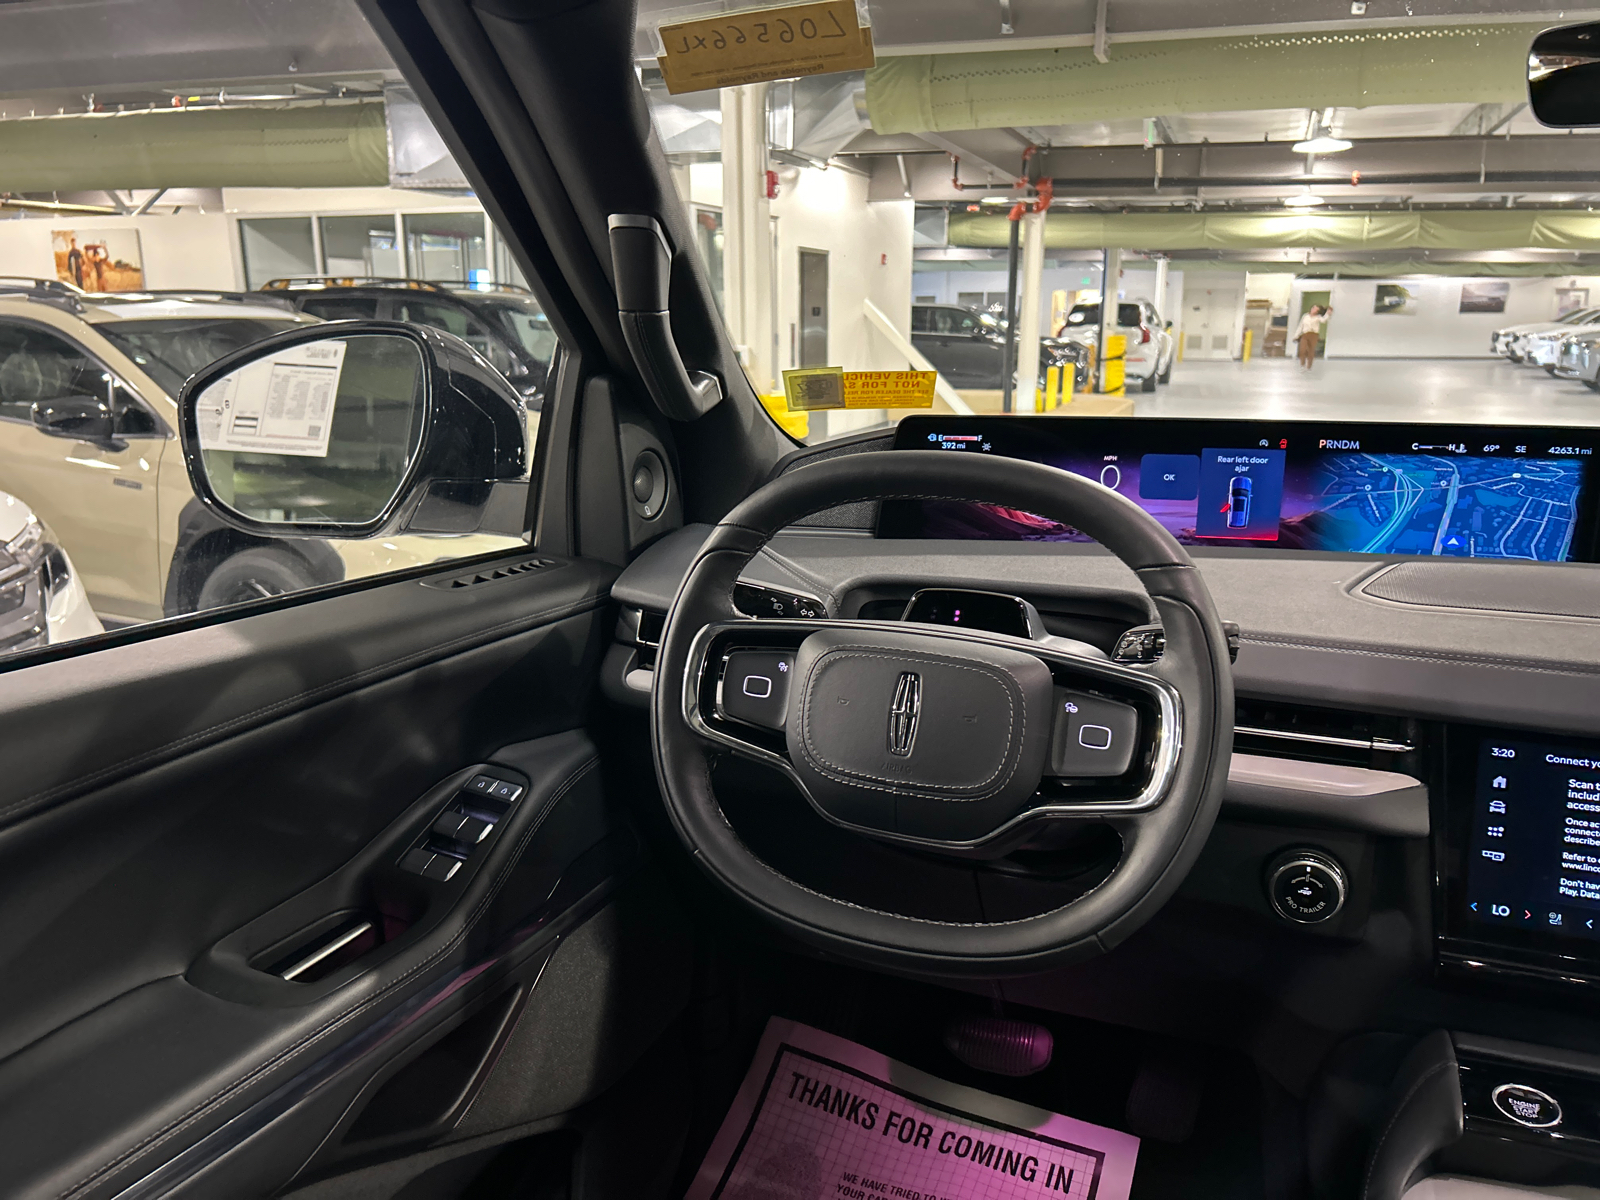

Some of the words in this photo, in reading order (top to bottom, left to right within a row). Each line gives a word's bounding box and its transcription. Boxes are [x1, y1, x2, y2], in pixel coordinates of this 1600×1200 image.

[938, 434, 943, 442] E
[977, 434, 983, 442] F
[1319, 439, 1360, 450] PRNDM
[1412, 443, 1419, 451] C
[1448, 443, 1456, 451] H
[1548, 447, 1579, 455] 4263.1
[1235, 456, 1249, 464] left
[1250, 456, 1269, 464] door
[1234, 465, 1250, 473] ajar
[1163, 473, 1176, 481] OK
[1491, 747, 1516, 758] 3:20
[1545, 754, 1590, 767] Connect
[1568, 779, 1594, 790] Scan
[1567, 789, 1600, 801] includ
[1565, 817, 1589, 827] Once
[1562, 851, 1586, 862] Refer
[1587, 855, 1597, 863] to
[1560, 877, 1584, 889] Don't
[1559, 886, 1579, 897] Play.
[1285, 896, 1298, 909] PRO
[1299, 901, 1327, 914] TRAILER
[1492, 904, 1510, 917] LO
[788, 1071, 880, 1132] THANKS
[882, 1114, 935, 1150] FOR
[937, 1130, 1041, 1184] COMING
[1044, 1163, 1076, 1195] IN
[842, 1171, 860, 1185] WE
[860, 1176, 889, 1193] HAVE
[890, 1184, 921, 1200] TRIED
[836, 1183, 866, 1200] YOUR
